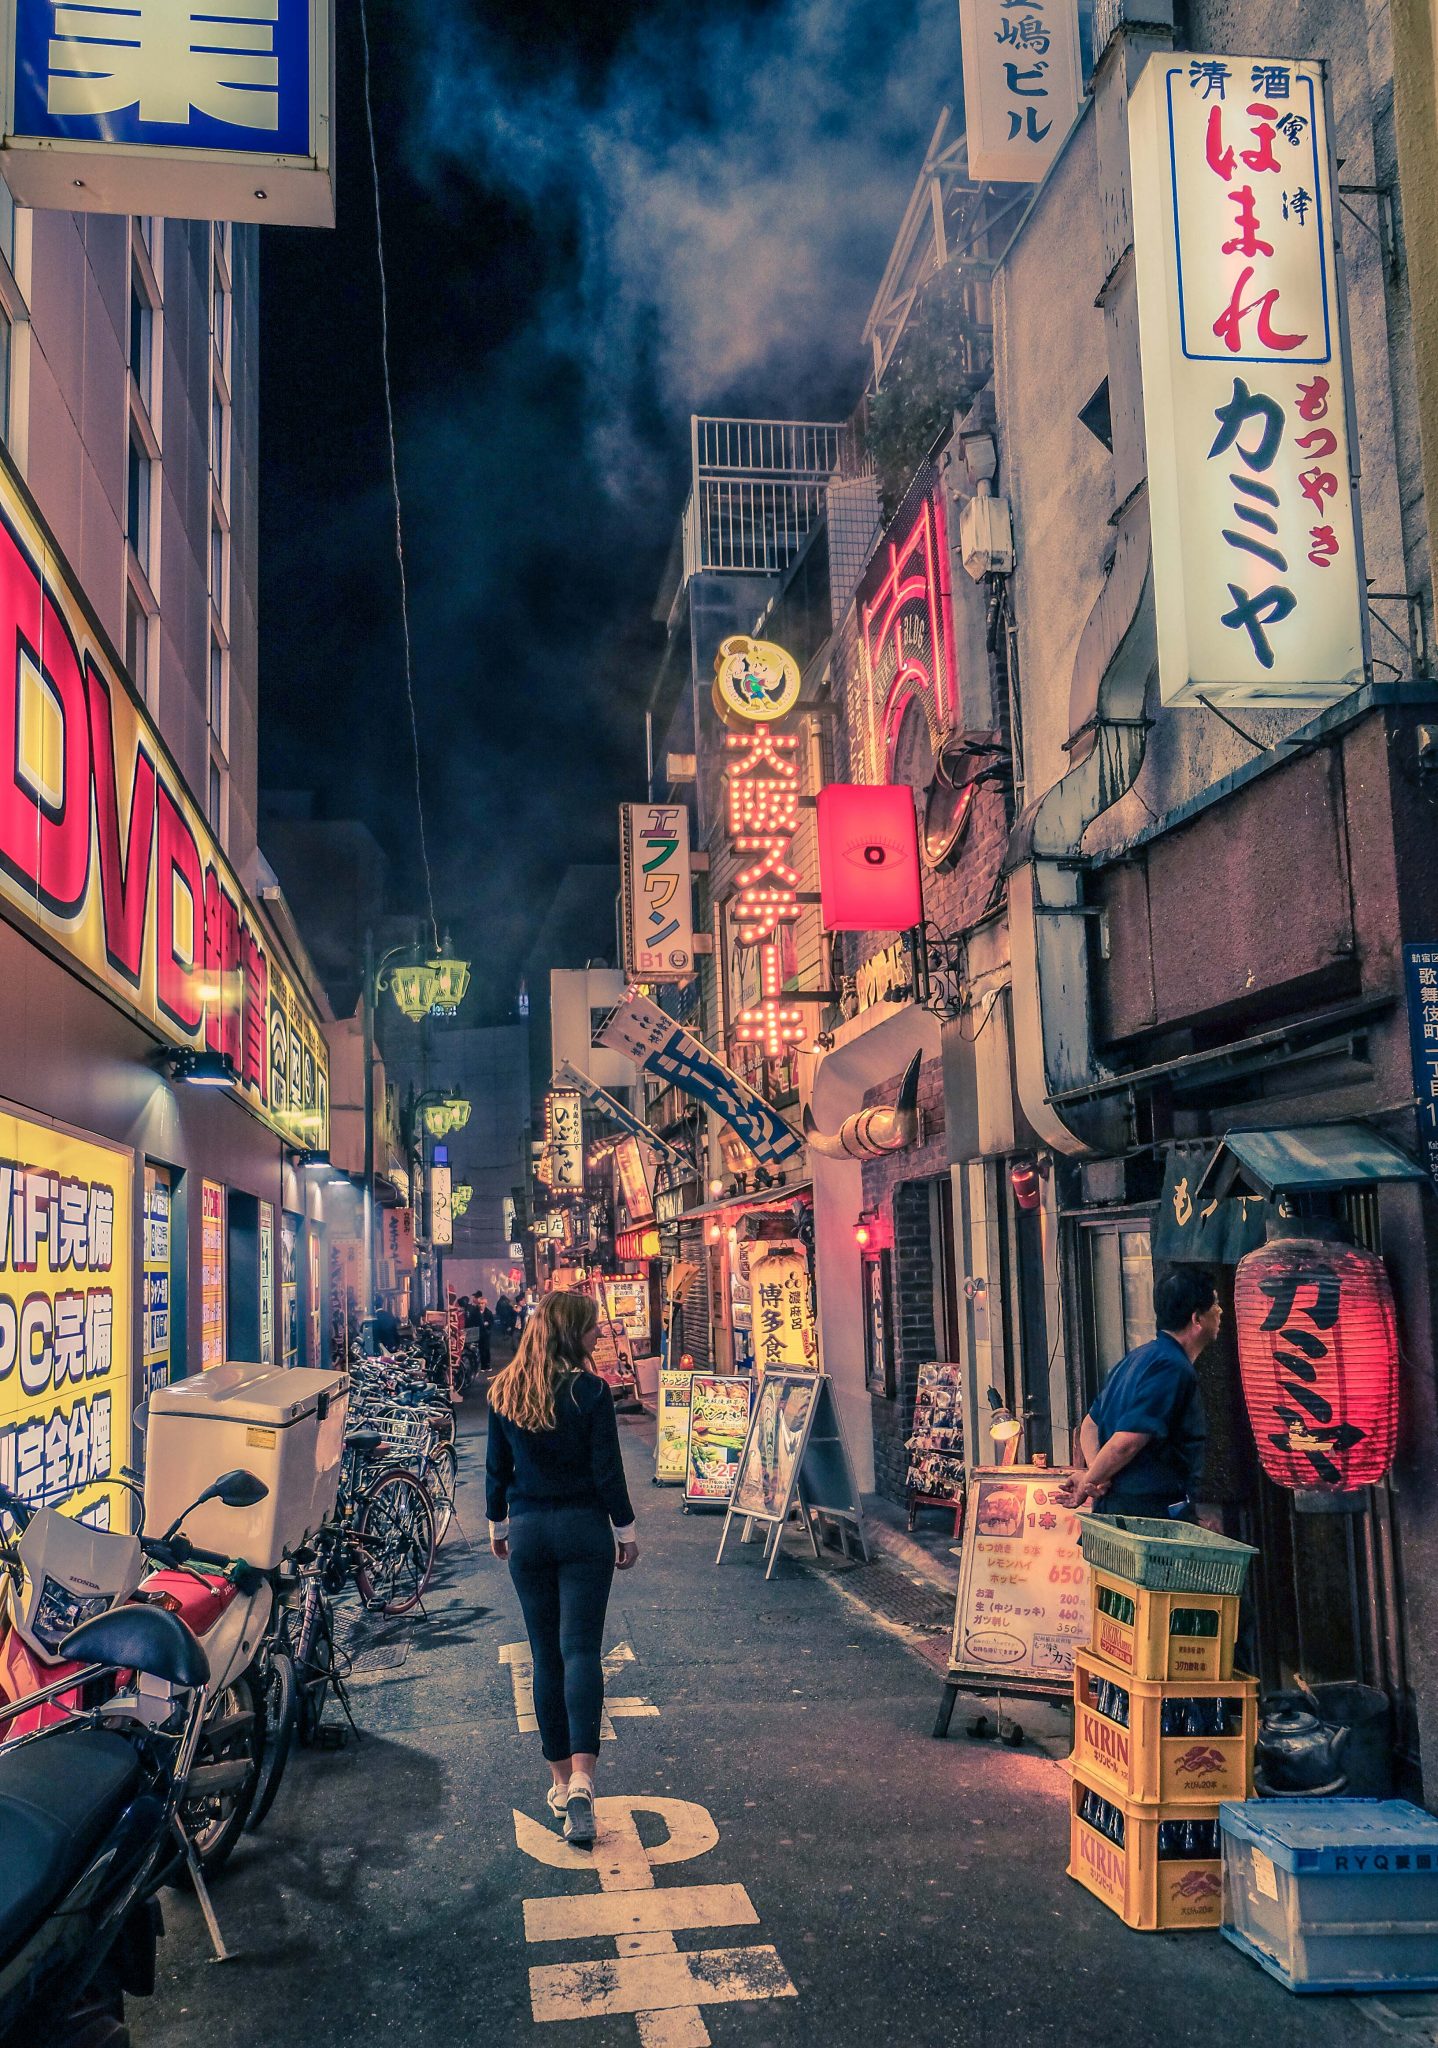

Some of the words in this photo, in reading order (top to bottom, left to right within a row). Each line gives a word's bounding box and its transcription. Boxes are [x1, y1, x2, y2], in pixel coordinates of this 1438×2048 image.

[1190, 60, 1291, 101] 清酒
[1205, 104, 1308, 354] ほまれ
[1295, 375, 1340, 568] もつやき
[1206, 376, 1298, 670] カミヤ
[639, 808, 681, 948] エフワン
[726, 724, 807, 1056] 大阪ステーキ
[640, 952, 665, 969] B1
[759, 1282, 788, 1362] 博多食
[1258, 1265, 1366, 1483] カミヤ
[69, 1576, 100, 1590] HONDA
[1084, 1714, 1130, 1767] KIRIN
[1093, 1750, 1118, 1774] キリンビール
[1080, 1829, 1125, 1890] KIRIN
